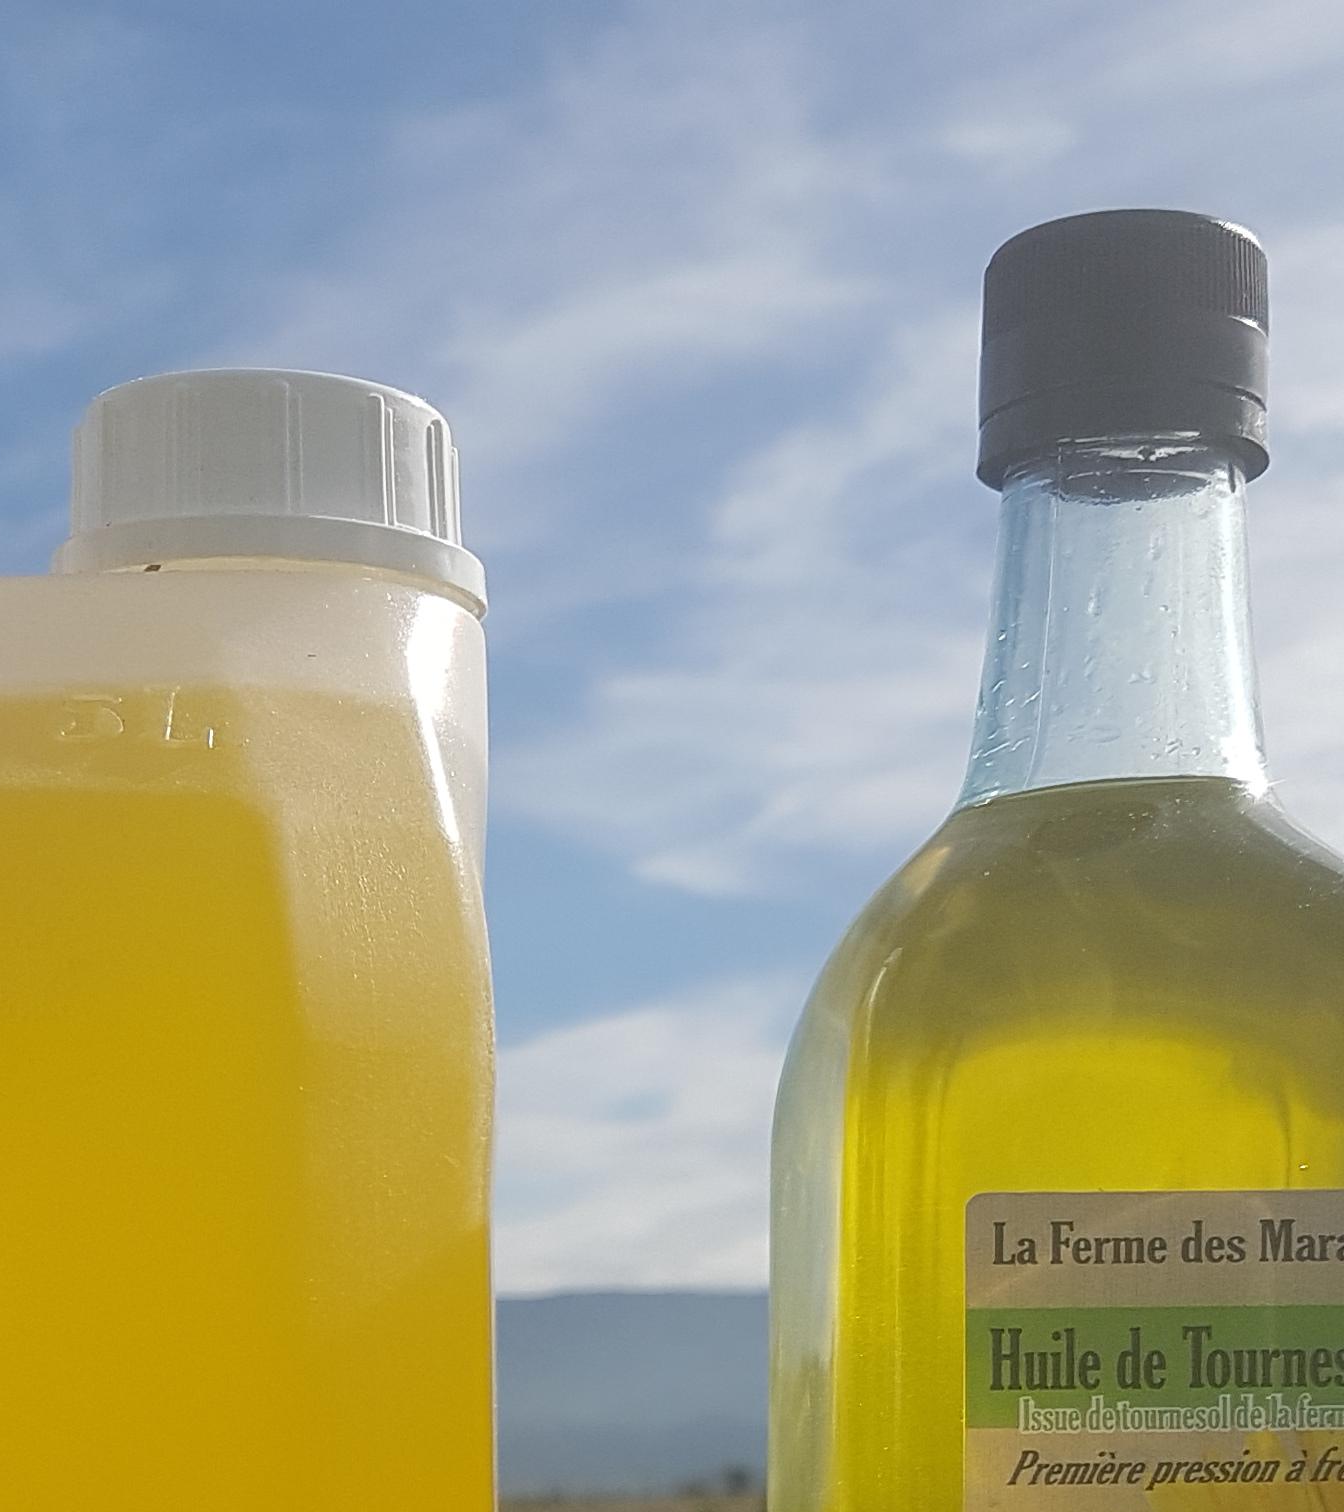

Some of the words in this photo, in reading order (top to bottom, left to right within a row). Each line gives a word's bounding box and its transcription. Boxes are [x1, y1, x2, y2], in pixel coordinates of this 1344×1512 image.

[992, 1221, 1038, 1265] La
[1050, 1221, 1168, 1265] Ferme
[1181, 1220, 1247, 1263] des
[989, 1327, 1102, 1391] Huile
[1116, 1327, 1167, 1390] de
[1019, 1397, 1085, 1434] Issue
[1085, 1396, 1117, 1433] de
[1116, 1394, 1233, 1432] tournesol
[1235, 1394, 1266, 1430] de
[1267, 1394, 1294, 1430] la
[1007, 1450, 1144, 1486] Première
[1147, 1449, 1281, 1490] pression
[1284, 1449, 1308, 1483] à
